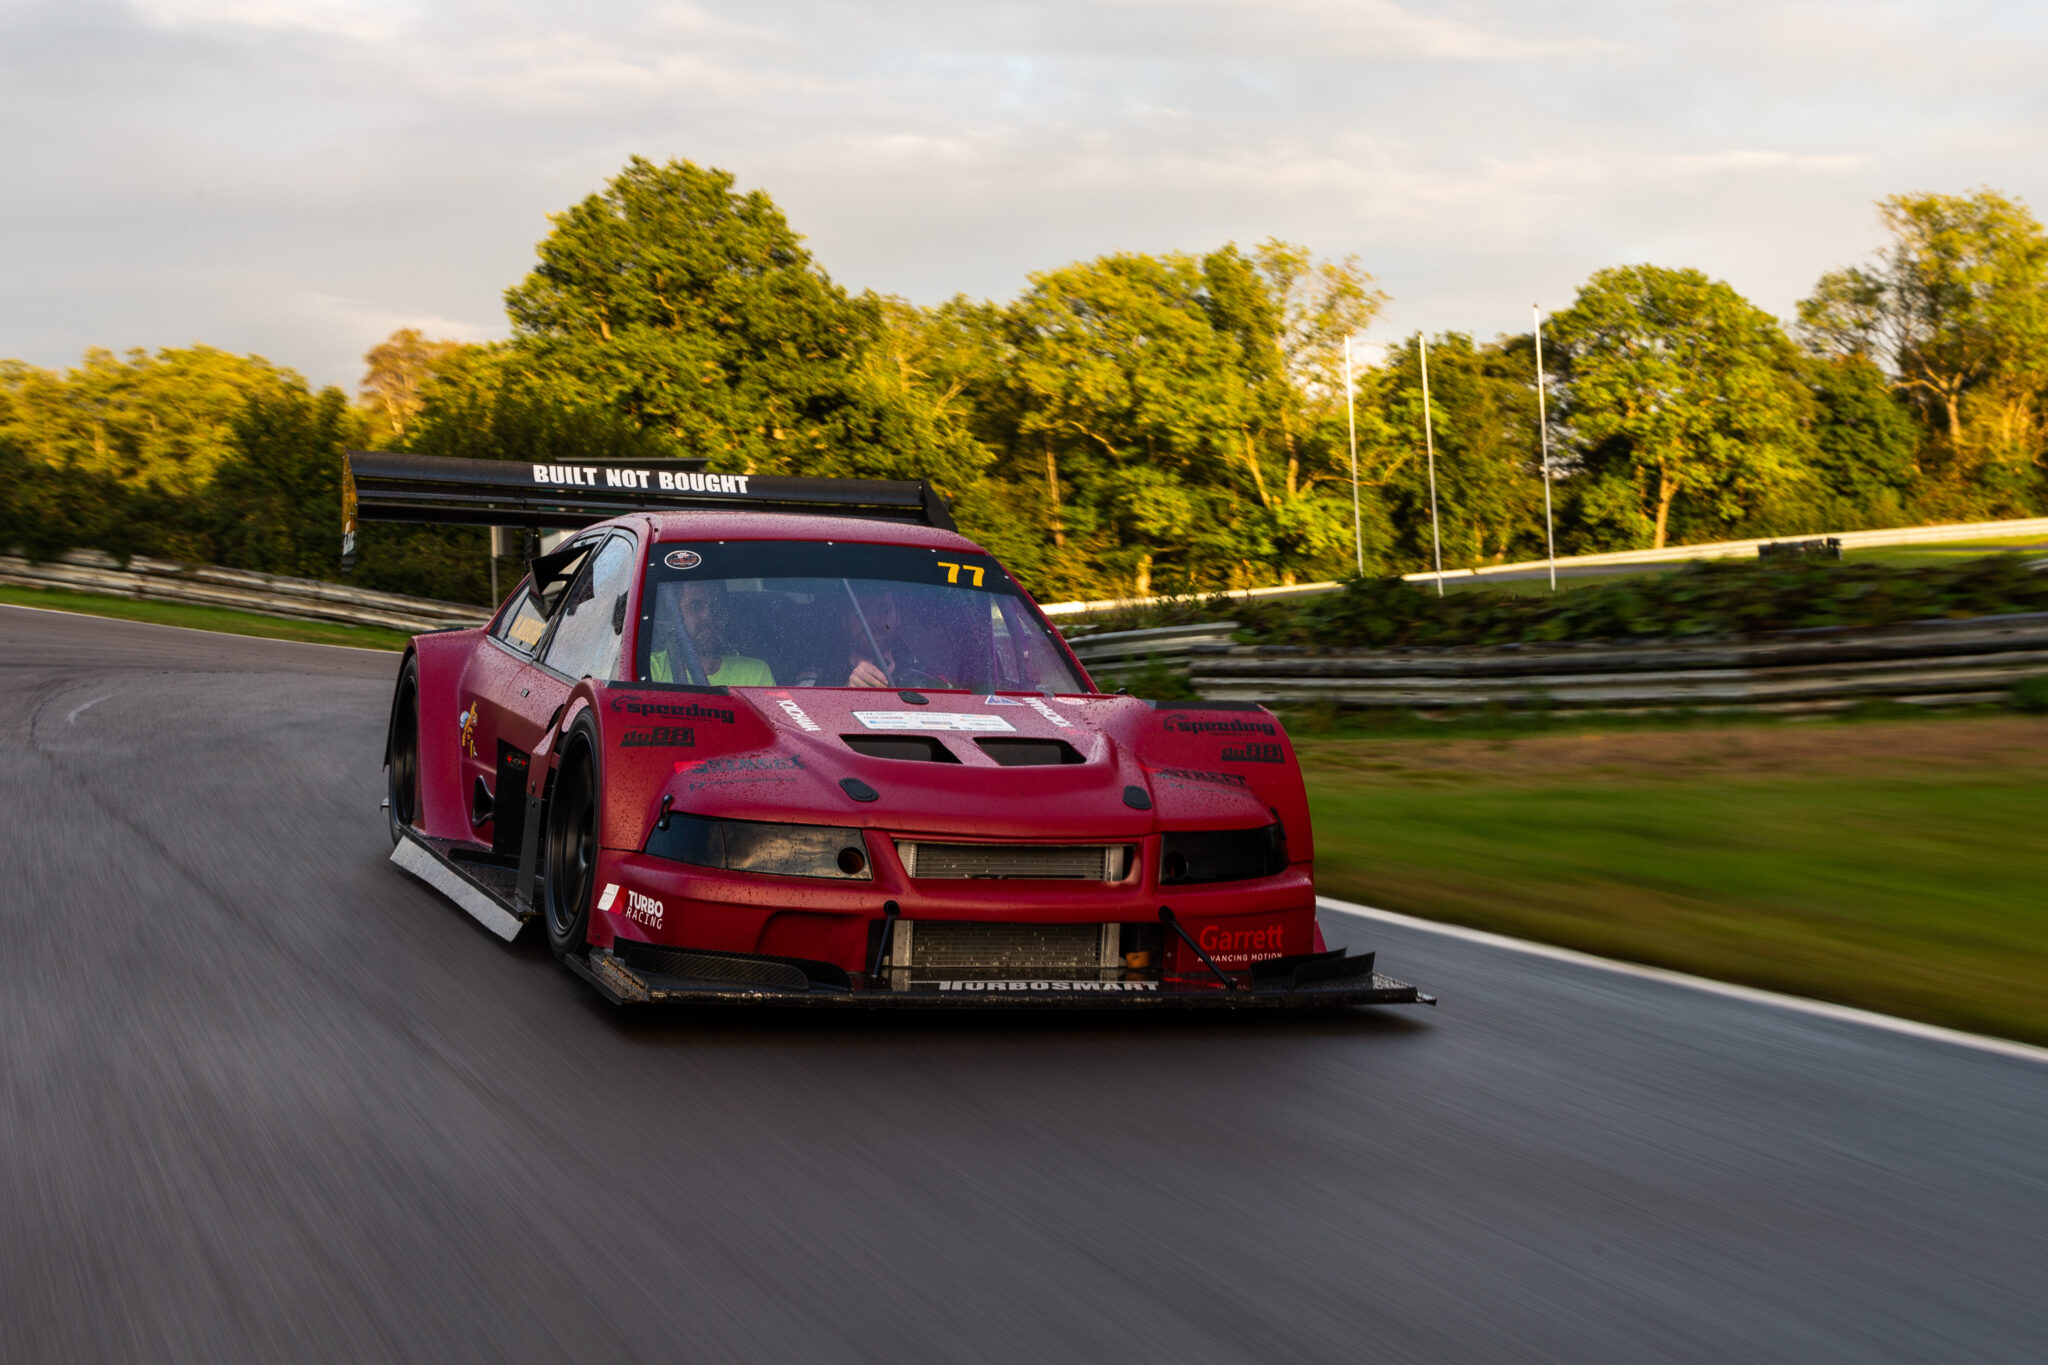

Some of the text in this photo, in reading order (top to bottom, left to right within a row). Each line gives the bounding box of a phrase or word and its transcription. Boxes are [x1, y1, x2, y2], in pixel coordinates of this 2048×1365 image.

[532, 464, 749, 494] BUILT NOT BOUGHT
[937, 561, 985, 587] 77
[626, 703, 735, 724] speeding
[1177, 719, 1277, 737] speeding
[628, 890, 664, 918] TURBO
[625, 907, 663, 930] RACING
[1199, 924, 1284, 951] Garrett
[1197, 954, 1249, 963] AVANCING
